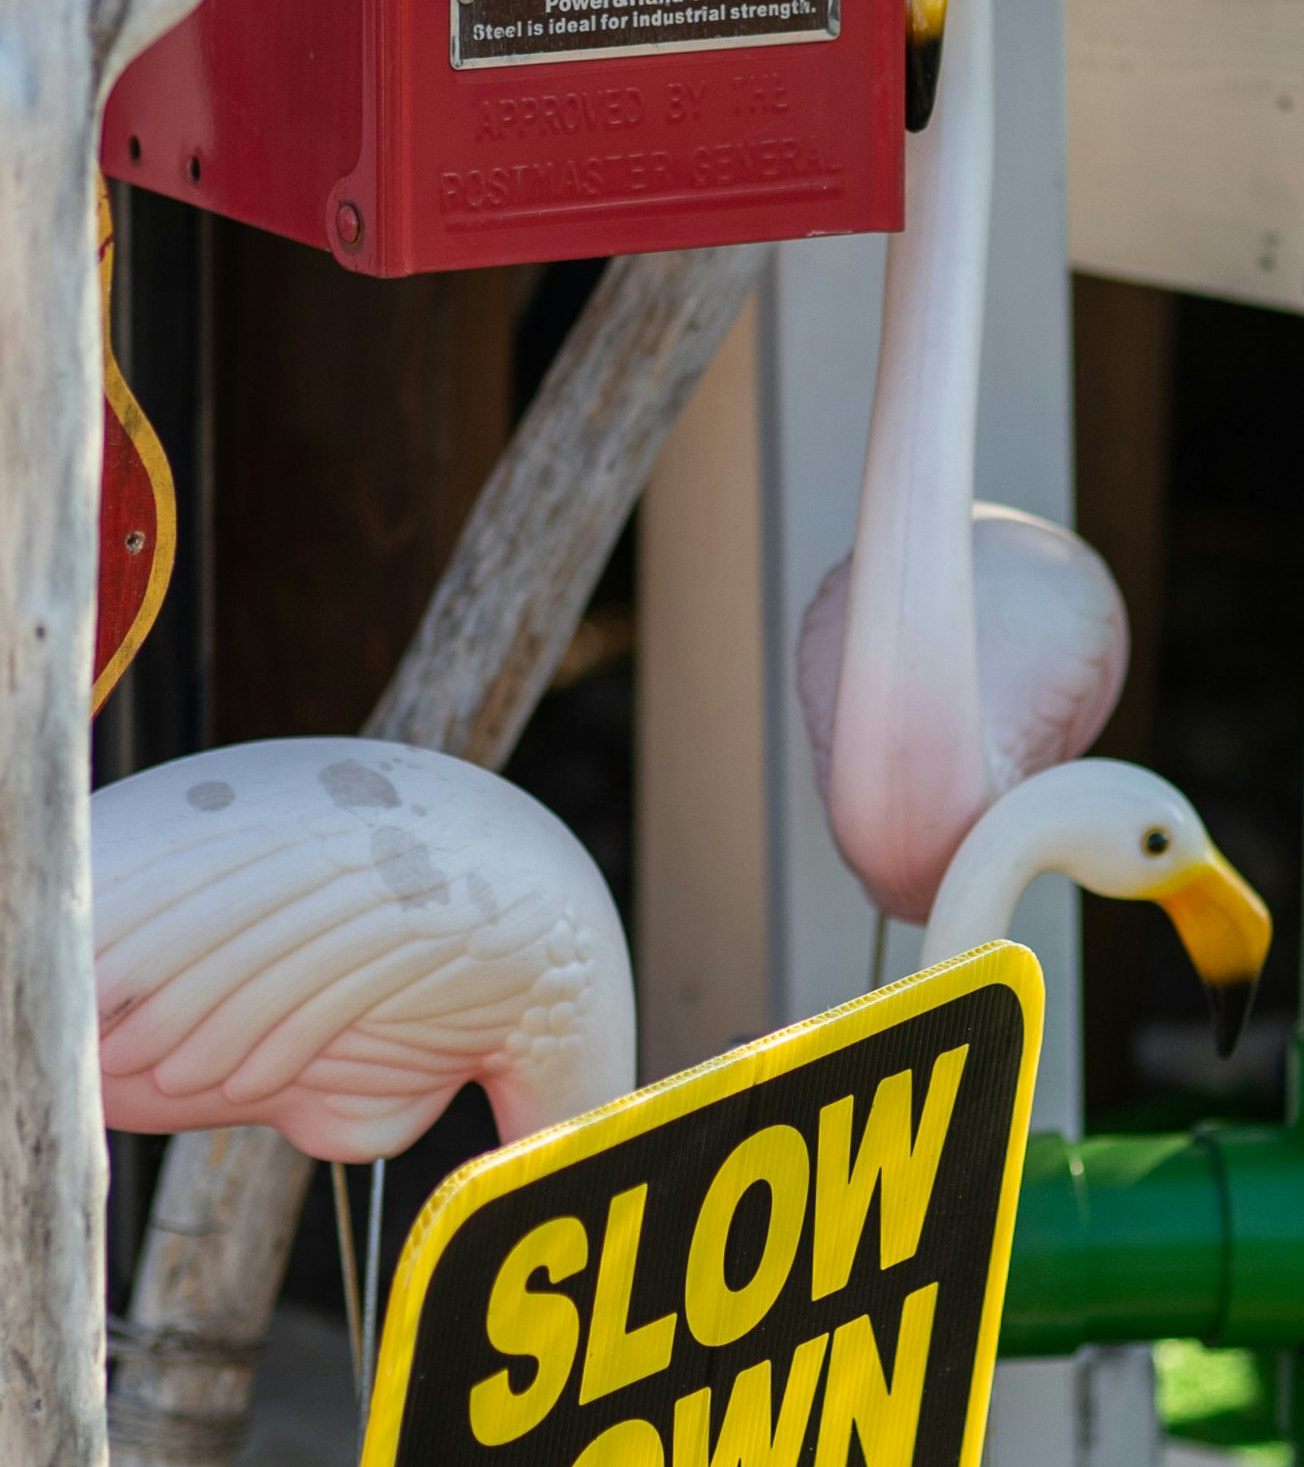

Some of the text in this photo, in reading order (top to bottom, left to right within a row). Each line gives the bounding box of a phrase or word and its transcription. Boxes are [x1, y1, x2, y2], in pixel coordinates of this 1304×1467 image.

[472, 20, 523, 42] Steel
[526, 19, 544, 36] is
[548, 14, 596, 36] ideal
[600, 11, 628, 31] for
[632, 3, 726, 28] industrial
[474, 86, 646, 143] APPROVED
[469, 1043, 969, 1447] SLOW
